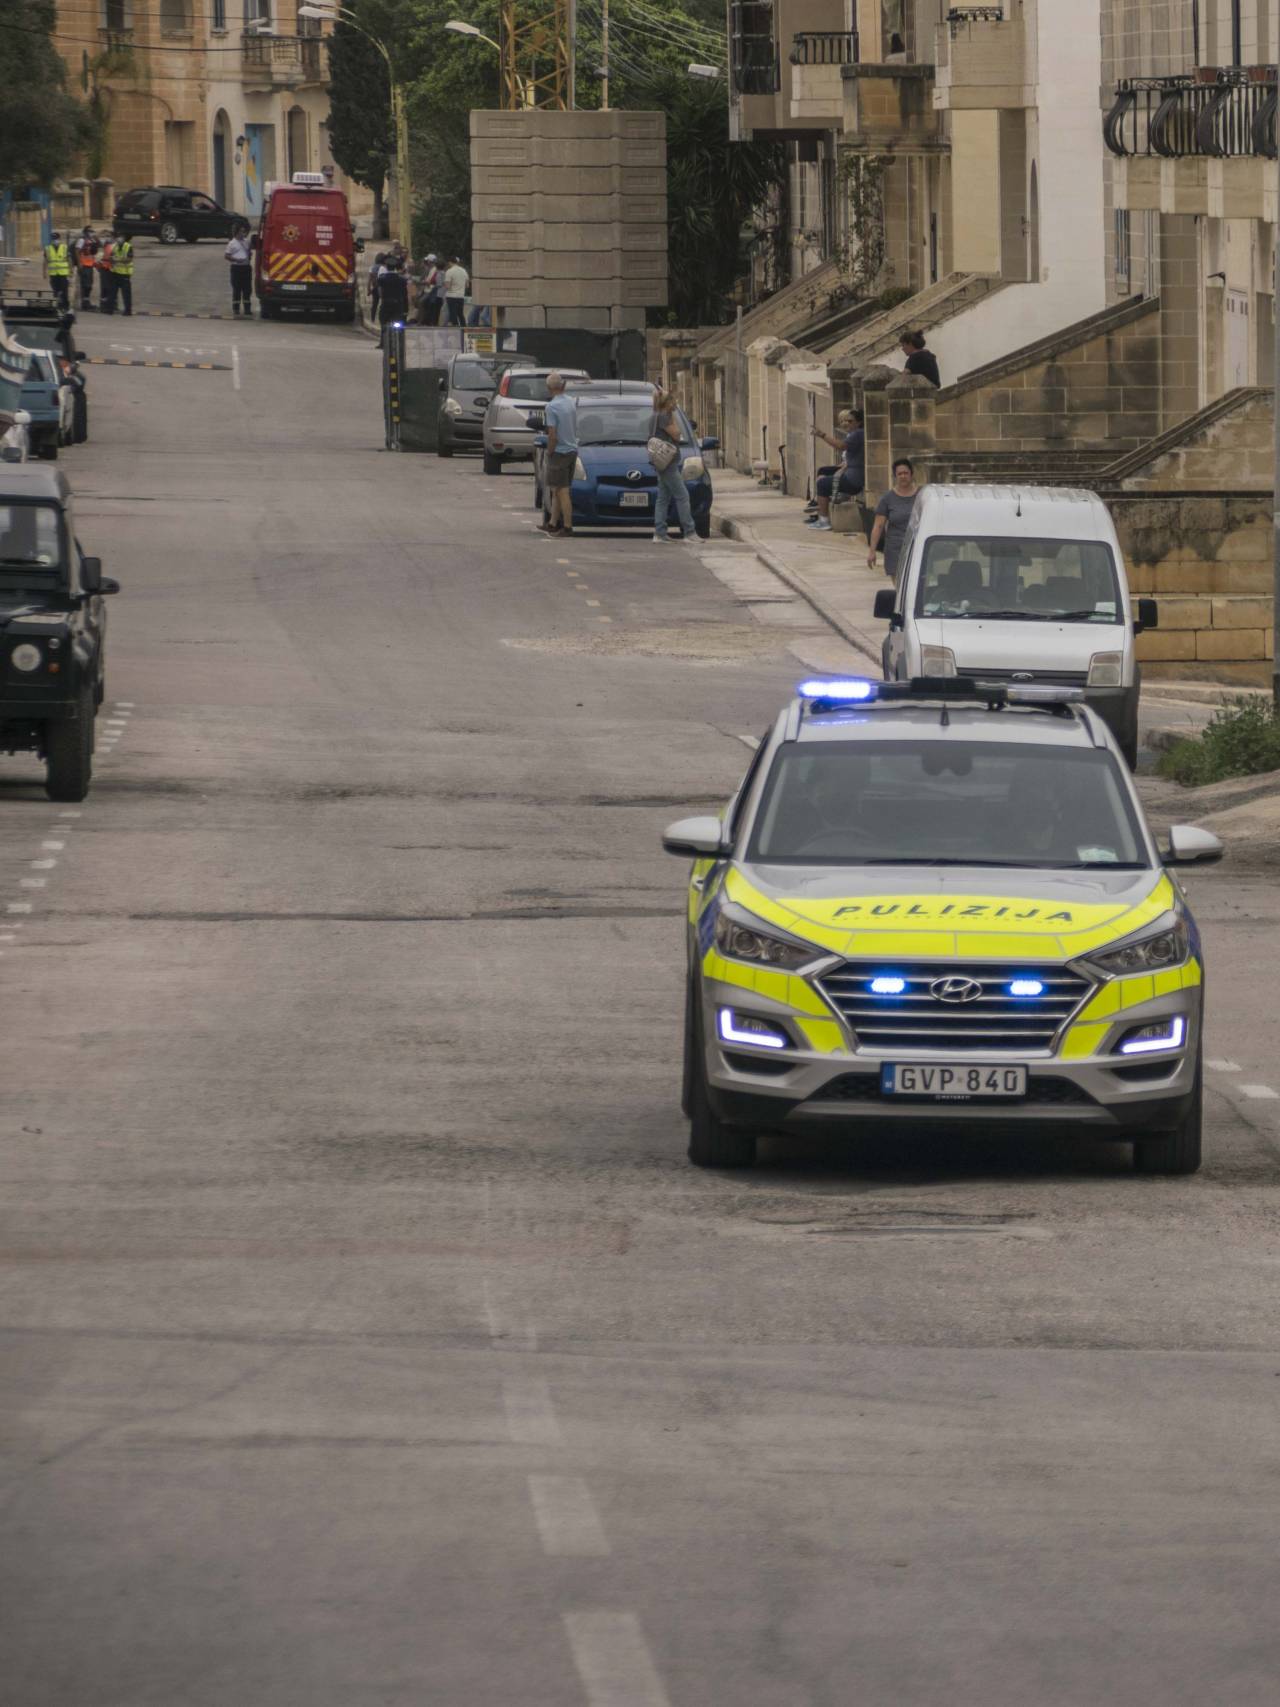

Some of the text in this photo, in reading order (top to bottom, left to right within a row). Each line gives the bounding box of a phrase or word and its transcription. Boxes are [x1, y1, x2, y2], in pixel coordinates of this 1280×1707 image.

[109, 343, 219, 355] STOP
[832, 904, 1073, 921] PULIZIJA
[901, 1068, 1018, 1092] GVP 840
